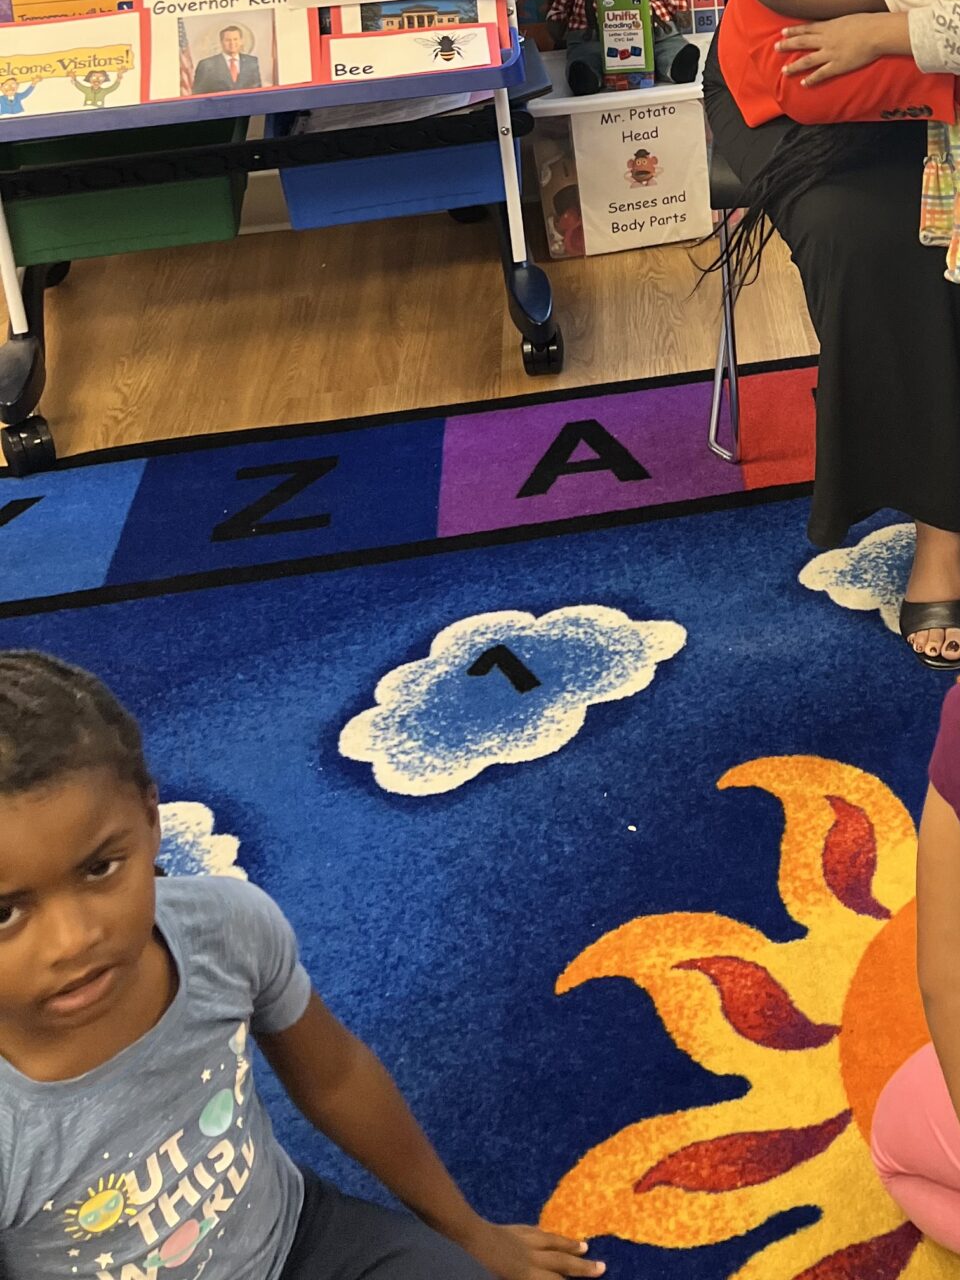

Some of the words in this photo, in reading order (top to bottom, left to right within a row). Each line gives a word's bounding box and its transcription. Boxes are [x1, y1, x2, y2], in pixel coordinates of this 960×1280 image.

[604, 21, 632, 29] Reading
[606, 11, 638, 21] Unifix
[697, 15, 713, 26] 85
[0, 62, 56, 77] elcome,
[57, 49, 130, 70] Visitors!
[334, 63, 374, 77] Bee
[600, 113, 625, 125] Mr.
[629, 105, 676, 122] Potato
[621, 127, 659, 143] Head
[608, 197, 658, 214] Senses
[662, 191, 686, 205] and
[611, 219, 645, 234] Body
[650, 212, 687, 227] Parts
[212, 454, 340, 543] Z
[515, 419, 652, 499] A
[466, 644, 541, 694] 1
